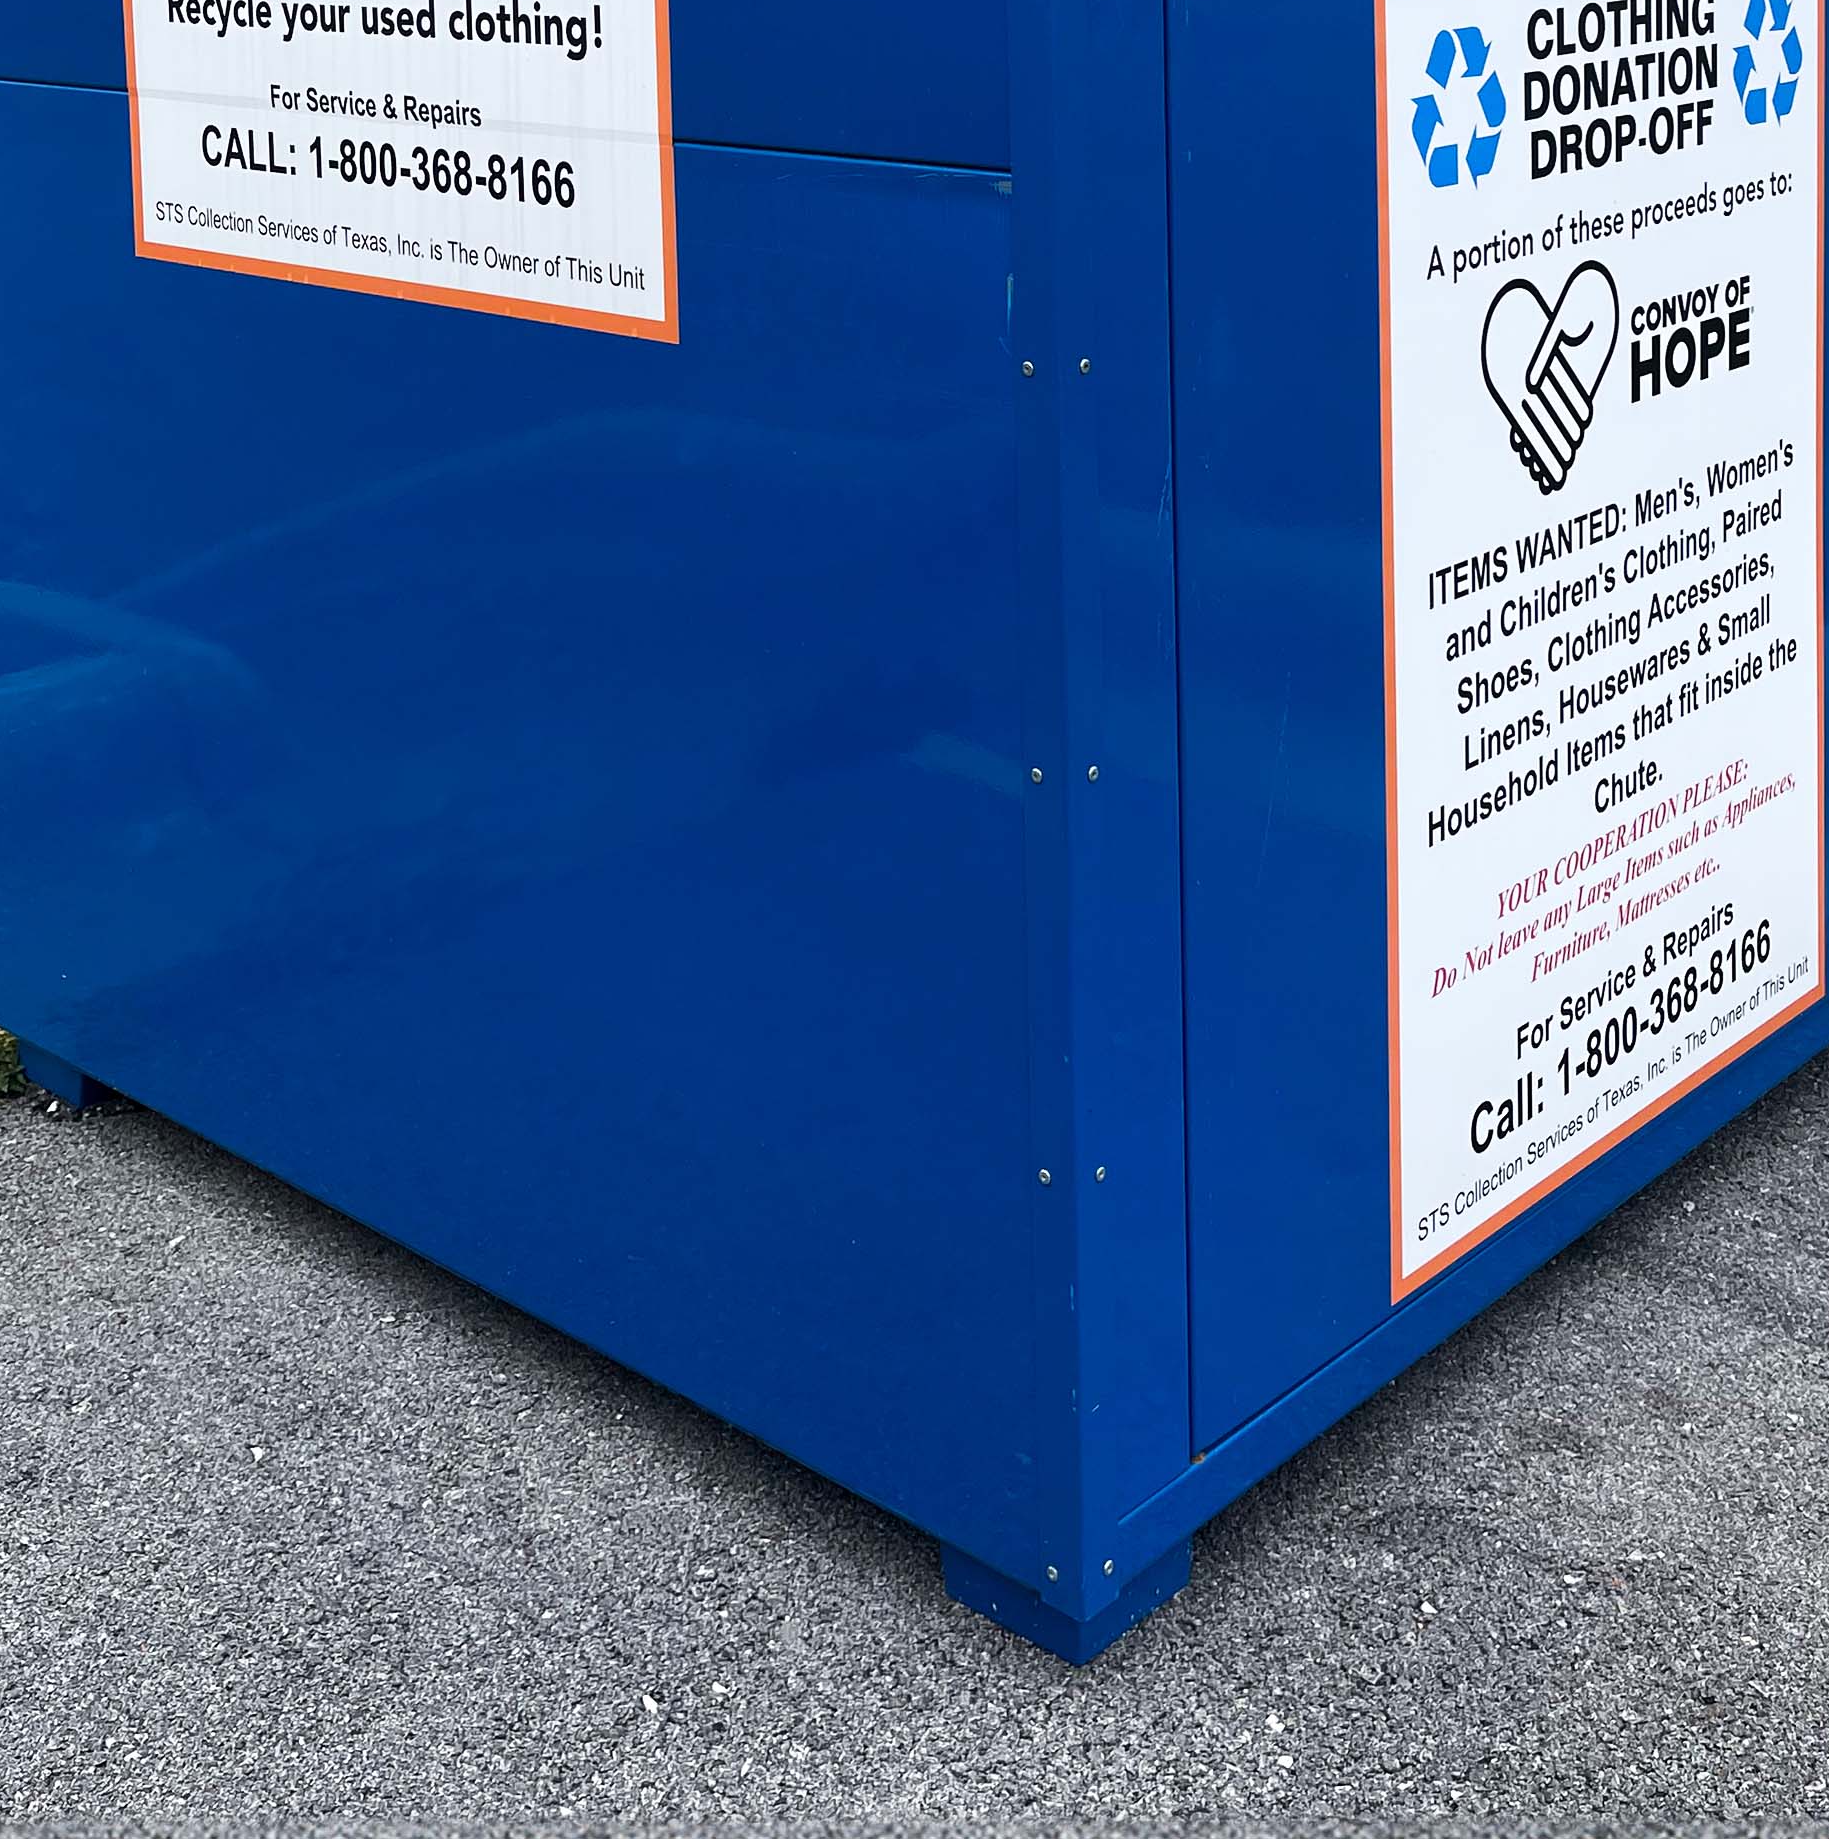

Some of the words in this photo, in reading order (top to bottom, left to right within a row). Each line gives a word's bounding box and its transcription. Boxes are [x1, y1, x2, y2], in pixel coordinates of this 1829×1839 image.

[282, 2, 350, 41] your
[1524, 44, 1718, 121] DONATION
[201, 125, 297, 176] CALL:
[309, 136, 575, 208] 1-800-368-8166
[270, 84, 300, 111] For
[306, 88, 377, 118] Service
[383, 93, 397, 120] &
[403, 95, 482, 129] Repairs
[1530, 99, 1714, 180] DROP-OFF
[155, 201, 184, 224] STS
[188, 206, 253, 233] Collection
[257, 215, 319, 243] Services
[323, 224, 337, 245] of
[342, 227, 391, 255] Texas,
[397, 234, 425, 258] Inc.
[430, 238, 442, 261] is
[447, 241, 479, 265] The
[484, 246, 539, 275] Owner
[544, 255, 561, 278] of
[566, 256, 603, 285] This
[609, 264, 645, 291] Unit
[1427, 245, 1444, 280] A
[1453, 229, 1534, 284] portion
[1542, 214, 1564, 249] of
[1569, 209, 1624, 245] these
[1632, 182, 1717, 239] proceeds
[1723, 176, 1764, 217] goes
[1770, 171, 1792, 197] to:
[1631, 284, 1719, 335] CONVOY
[1725, 275, 1750, 306] OF
[1428, 546, 1508, 610] ITEMS
[1515, 502, 1627, 574] WANTED:
[1635, 477, 1701, 527] Men's,
[1707, 439, 1794, 497] Women's
[1446, 610, 1492, 661] and
[1500, 562, 1615, 637] Children's
[1623, 526, 1715, 585] Clothing,
[1722, 490, 1782, 543] Paired
[1457, 658, 1539, 715] Shoes,
[1548, 608, 1640, 672] Clothing
[1647, 551, 1774, 629] Accessories,
[1464, 707, 1551, 771] Linens,
[1559, 639, 1690, 724] Housewares
[1698, 623, 1711, 656] &
[1718, 594, 1771, 646] Small
[1428, 748, 1559, 847] Household
[1566, 724, 1626, 777] Items
[1633, 699, 1673, 741] that
[1679, 681, 1699, 717] fit
[1705, 654, 1762, 706] inside
[1769, 637, 1797, 672] the
[1594, 759, 1663, 813] Chute.
[1431, 967, 1456, 998] Do
[1463, 943, 1493, 979] Not
[1498, 922, 1538, 959] leave
[1544, 903, 1572, 936] any
[1577, 875, 1620, 914] Large
[1624, 849, 1664, 885] Items
[1668, 820, 1700, 859] such
[1704, 815, 1718, 837] as
[1722, 770, 1797, 831] Appliances,
[1497, 868, 1550, 920] YOUR
[1554, 798, 1680, 886] COOPERATION
[1683, 759, 1749, 815] PLEASE:
[1516, 1016, 1553, 1060] For
[1560, 969, 1636, 1025] Service
[1643, 946, 1657, 974] &
[1663, 902, 1734, 965] Repairs
[1530, 919, 1611, 984] Furniture,
[1616, 866, 1690, 931] Mattresses
[1418, 1203, 1450, 1242] STS
[1454, 1154, 1523, 1217] Collection
[1527, 1115, 1584, 1165] Services
[1587, 1101, 1600, 1125] of
[1603, 1073, 1643, 1113] Texas,
[1647, 1060, 1668, 1083] Inc.
[1672, 1048, 1682, 1066] is
[1685, 1027, 1707, 1055] The
[1710, 1002, 1746, 1038] Owner
[1750, 992, 1760, 1011] of
[1763, 974, 1785, 1001] This
[1787, 956, 1809, 984] Unit
[1470, 1072, 1545, 1155] Call:
[1557, 919, 1771, 1096] 1-800-368-8166
